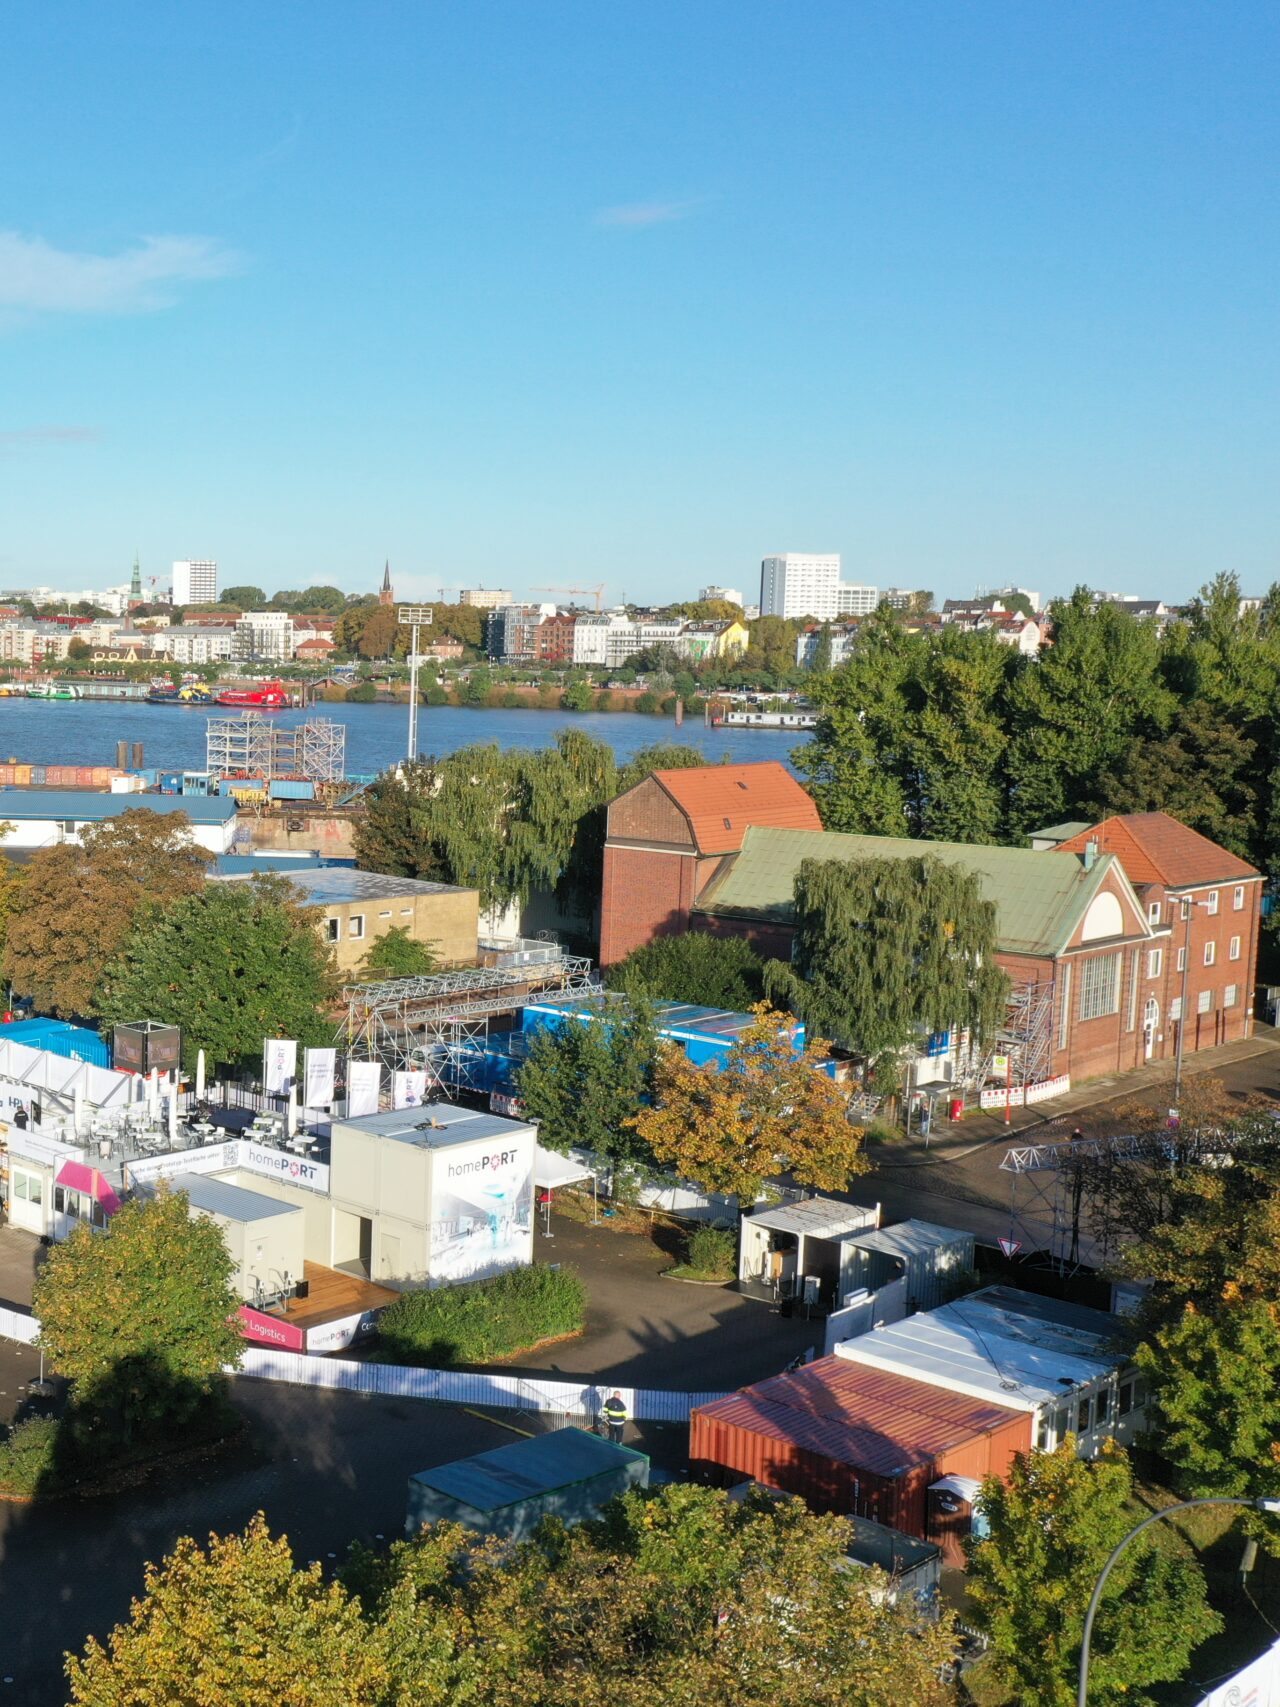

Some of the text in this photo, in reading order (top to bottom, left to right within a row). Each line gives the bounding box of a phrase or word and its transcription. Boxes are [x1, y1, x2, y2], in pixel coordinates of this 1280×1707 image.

[248, 1148, 317, 1180] homePORT
[448, 1149, 518, 1178] homePORT
[250, 1319, 286, 1343] Logistics
